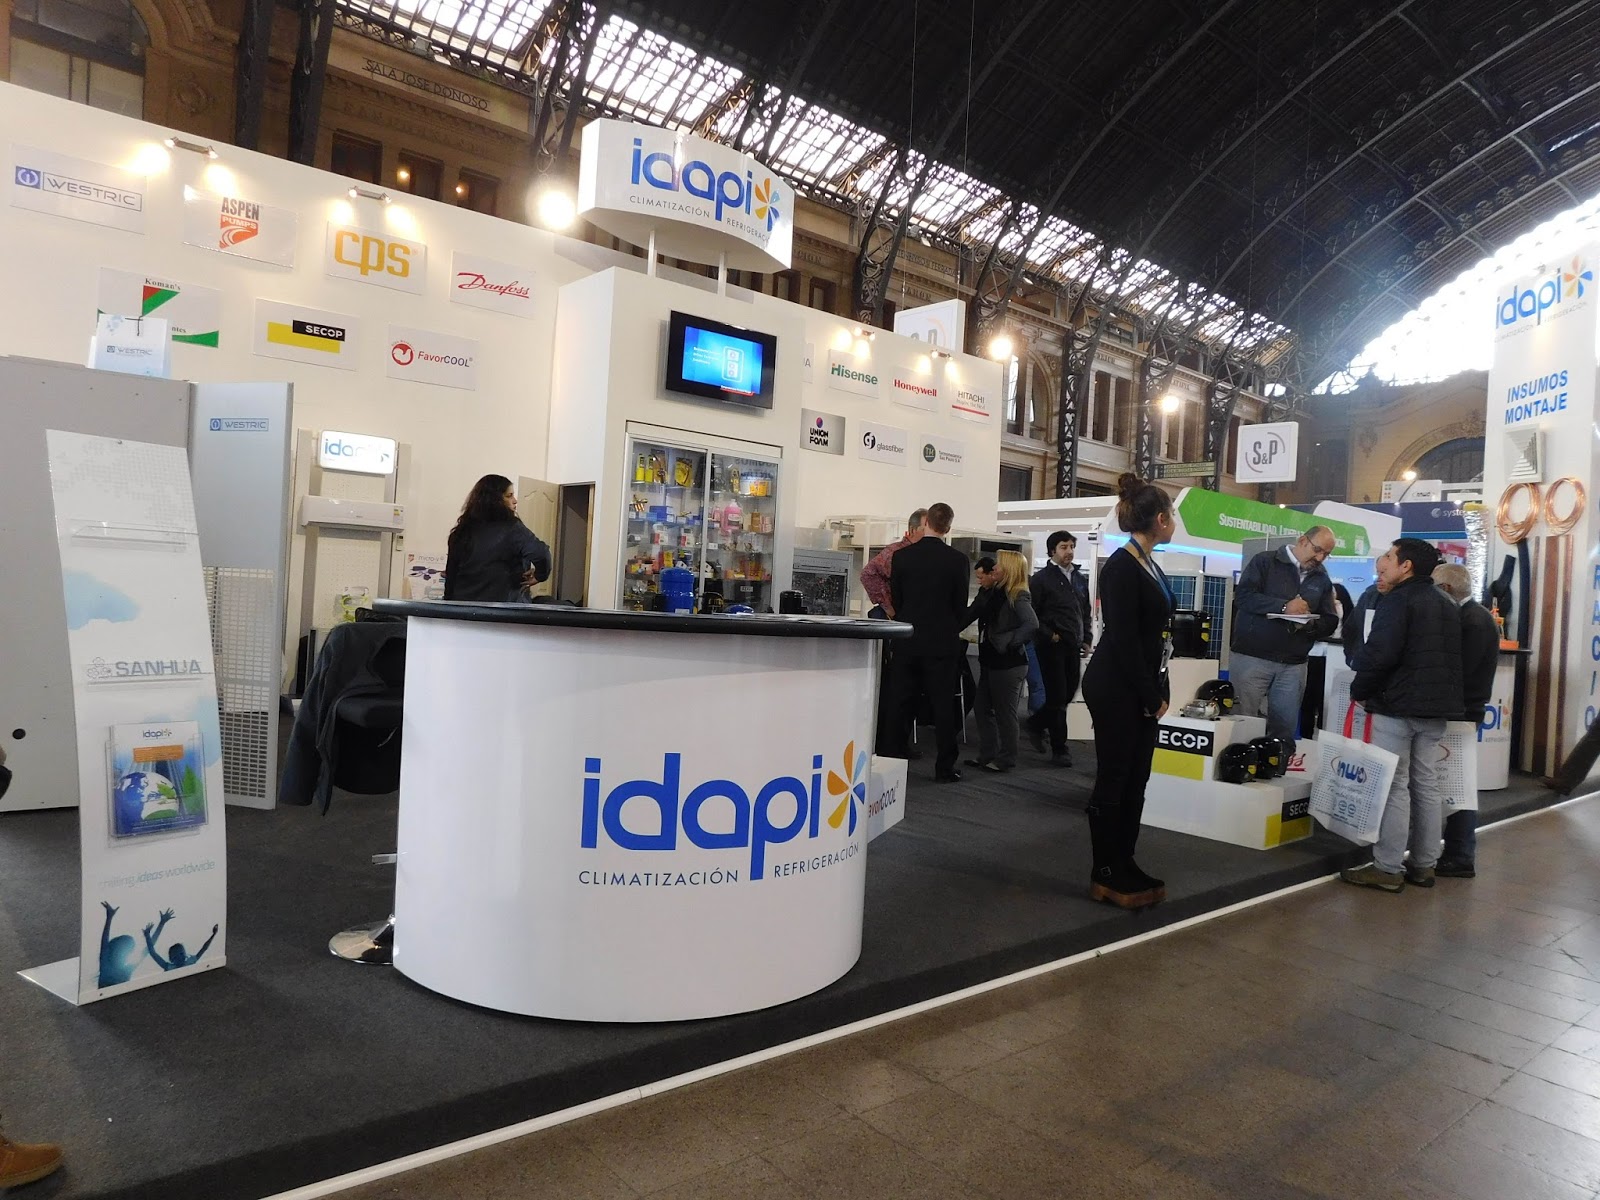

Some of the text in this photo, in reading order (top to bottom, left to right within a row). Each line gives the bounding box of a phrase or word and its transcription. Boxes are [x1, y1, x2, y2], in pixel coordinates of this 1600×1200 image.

[366, 59, 488, 110] SALA JOSE DONOSO
[47, 177, 136, 206] WESTRIC
[221, 197, 260, 221] ASPEN
[629, 195, 770, 244] CLIMATIZACIÓN REFRIGERACI
[222, 216, 258, 230] PUMPS
[334, 230, 411, 277] cps
[145, 278, 181, 290] Koman's
[457, 272, 529, 296] Danfoss
[1495, 267, 1562, 330] idapi
[305, 325, 343, 339] SECOP
[117, 347, 152, 355] WESTRIC
[831, 363, 878, 385] Hisense
[894, 379, 937, 397] Honeywell
[957, 390, 985, 404] HITACHI
[1507, 370, 1568, 404] INSUMOS
[1504, 392, 1567, 425] MONTAJE
[224, 420, 267, 430] WESTRIC
[809, 427, 829, 438] UNION
[809, 436, 829, 447] FOAM
[876, 438, 904, 454] glassfiber
[1252, 440, 1278, 466] S&P
[115, 659, 202, 677] SANHUA
[143, 729, 163, 740] idapi
[1158, 729, 1210, 750] ECOP
[868, 787, 897, 818] avorCOOL
[1289, 801, 1309, 817] SECO
[581, 752, 823, 881] idapi
[578, 844, 859, 886] CLIMATIZACIÓN REFRIGERACIÓN
